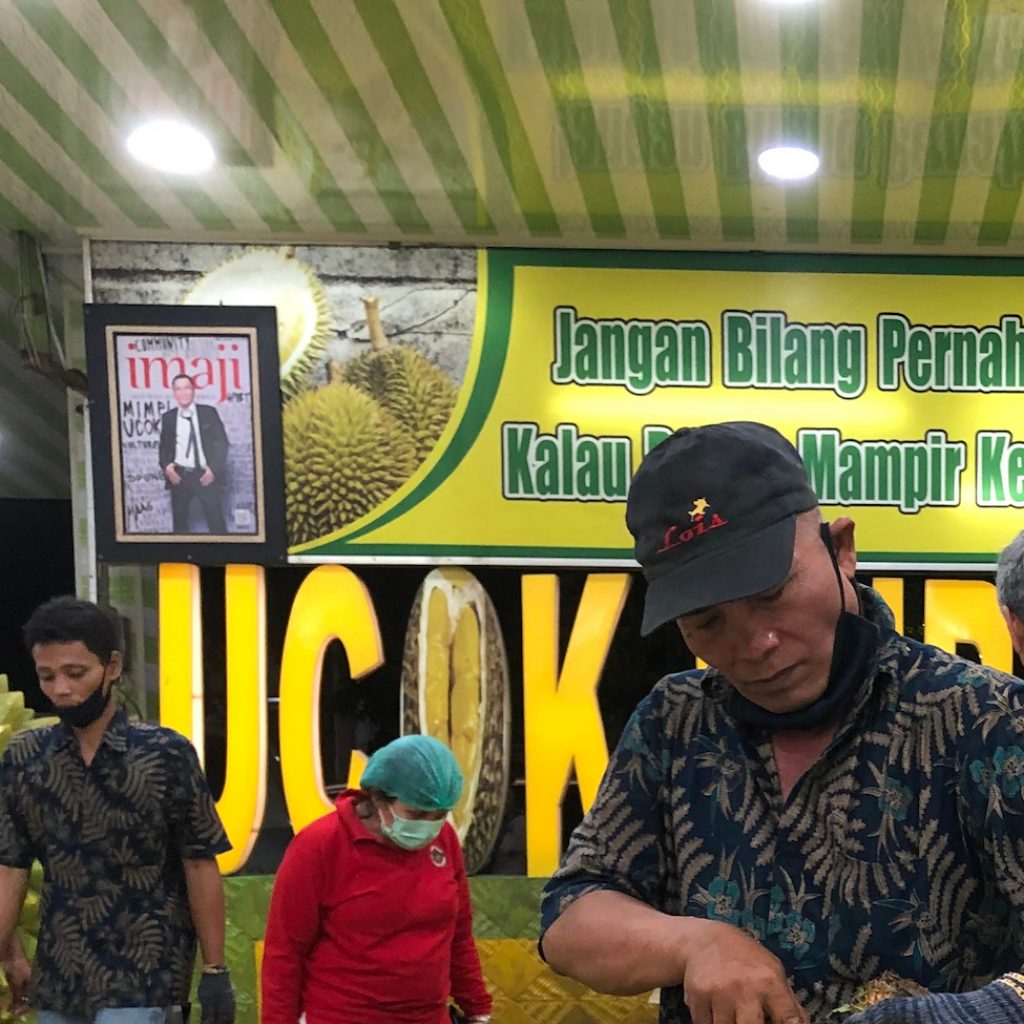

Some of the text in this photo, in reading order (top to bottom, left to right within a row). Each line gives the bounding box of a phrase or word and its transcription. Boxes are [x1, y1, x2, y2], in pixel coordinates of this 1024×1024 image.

[125, 343, 243, 404] imaji
[550, 305, 713, 395] Jangan
[721, 309, 867, 398] Bilang
[502, 421, 633, 503] Kalau
[797, 428, 967, 514] Mampir
